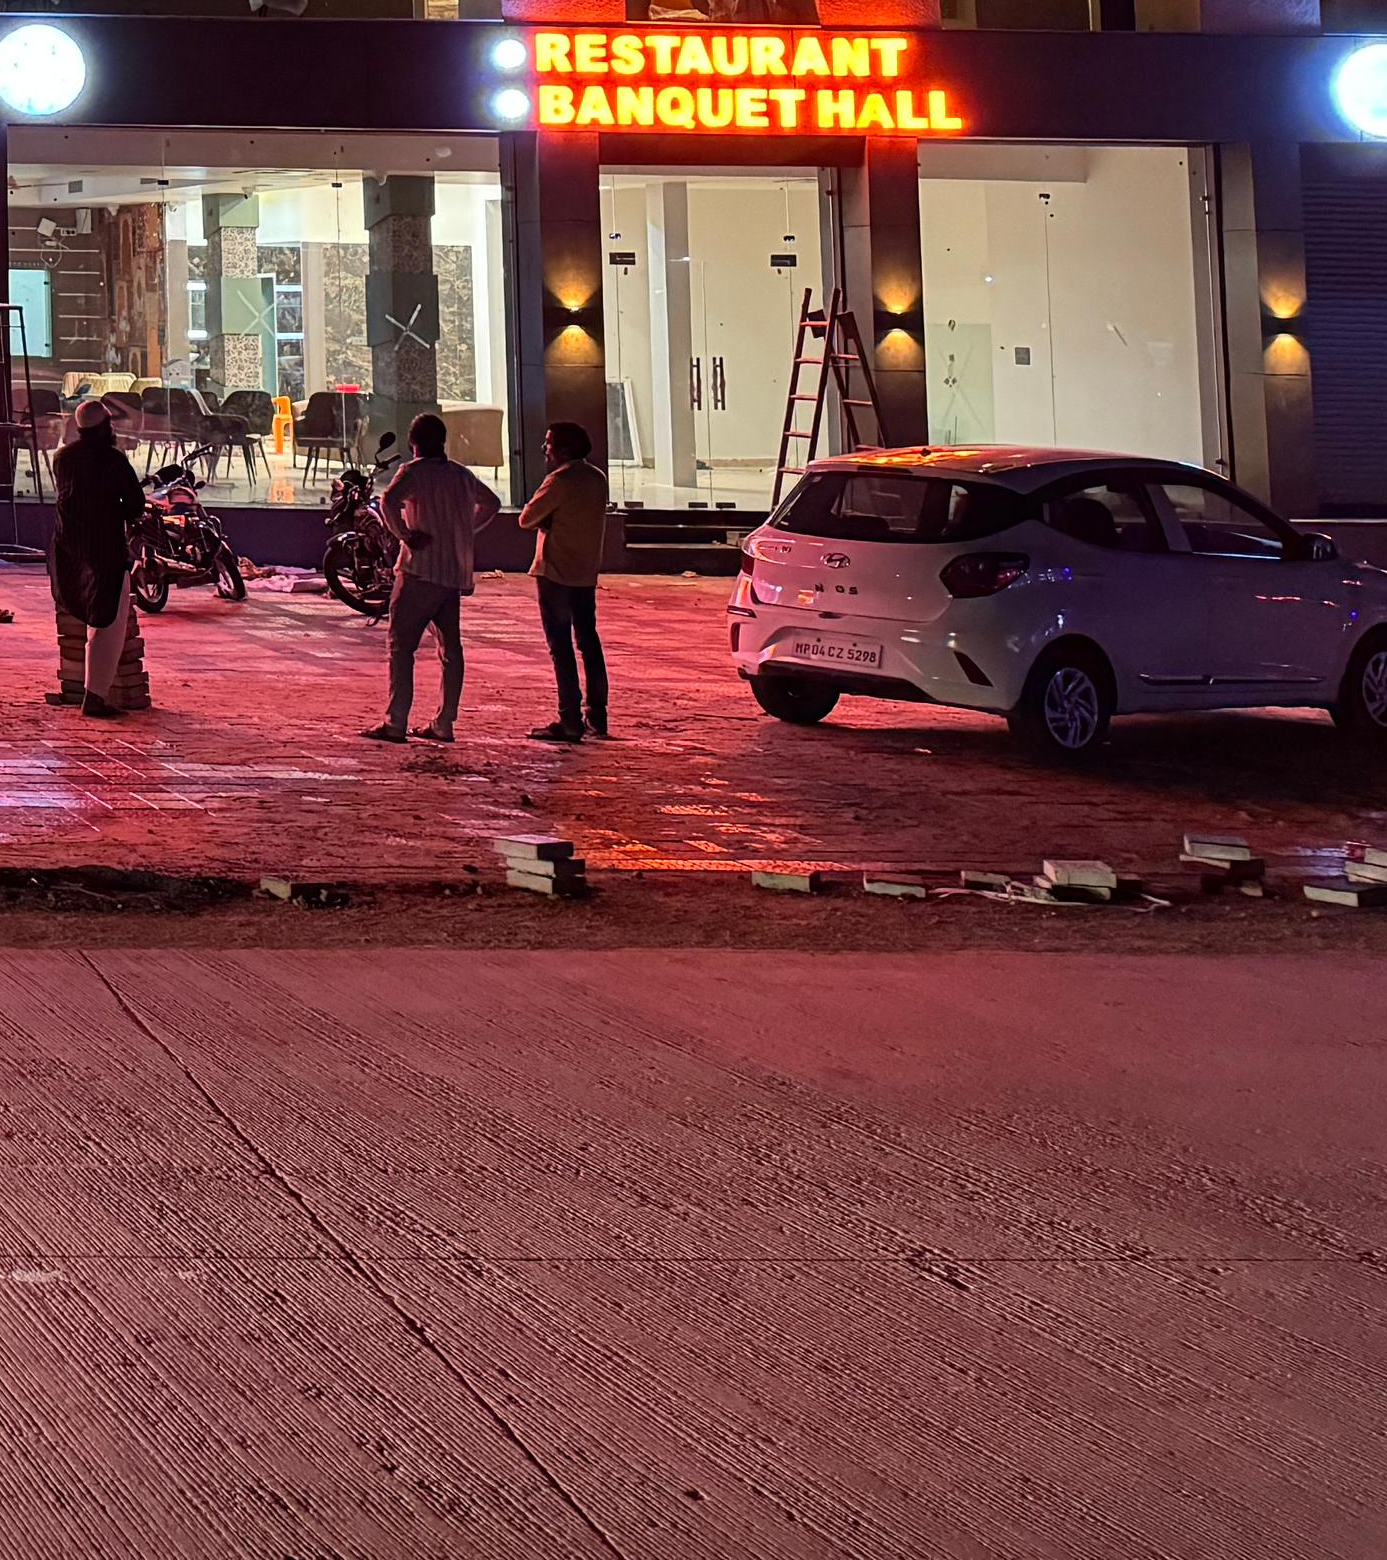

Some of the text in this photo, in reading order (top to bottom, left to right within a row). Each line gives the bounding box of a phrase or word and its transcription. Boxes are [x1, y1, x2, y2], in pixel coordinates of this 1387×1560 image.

[535, 33, 908, 77] RESTAURANT
[538, 85, 963, 130] BANQUET HALL
[815, 583, 858, 595] NOS
